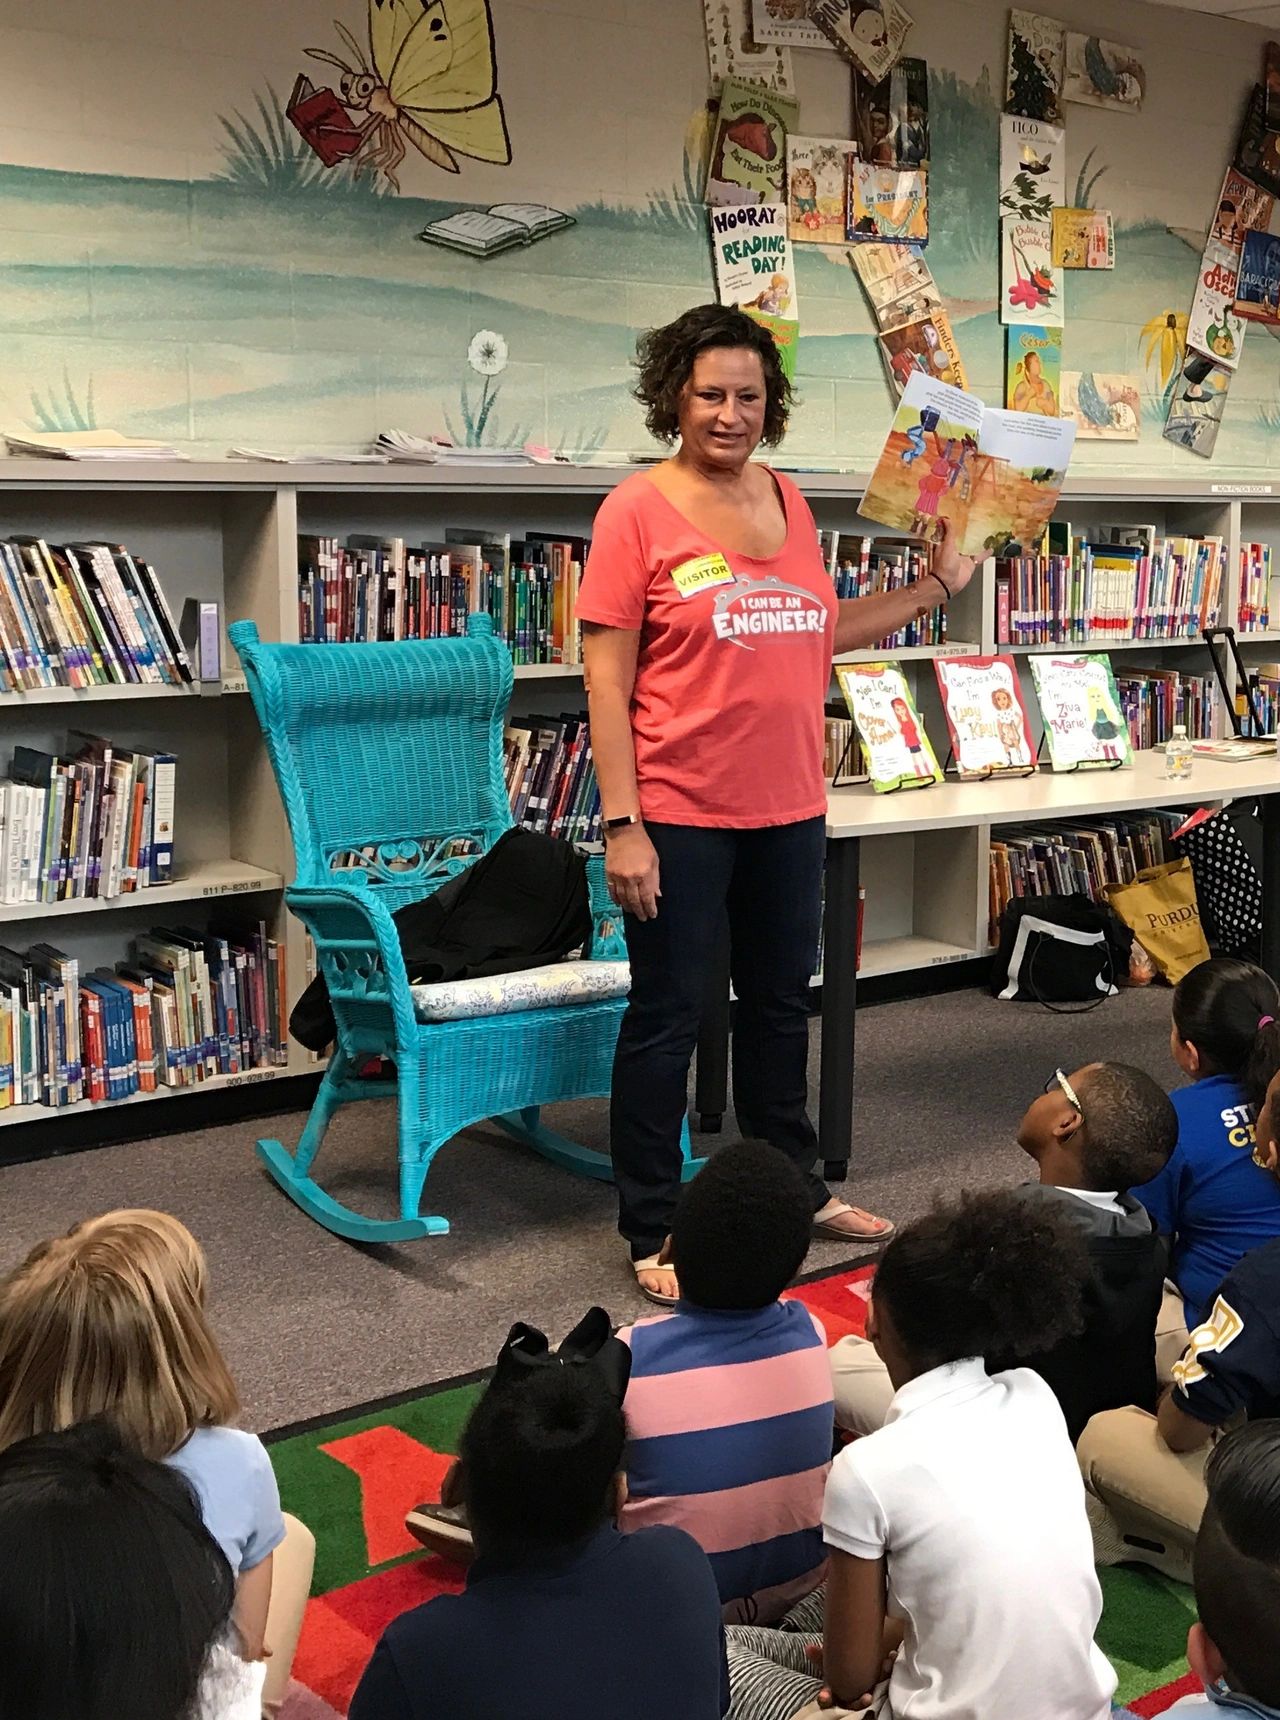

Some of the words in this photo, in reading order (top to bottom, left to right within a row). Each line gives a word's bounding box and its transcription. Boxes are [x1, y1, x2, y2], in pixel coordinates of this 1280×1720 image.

[1012, 121, 1039, 136] TICO
[714, 206, 777, 234] HOORAY
[721, 235, 786, 266] READING
[751, 256, 786, 275] DAY!
[1203, 270, 1236, 300] Osca
[934, 317, 955, 361] Finders
[679, 564, 729, 587] VISITOR
[739, 597, 746, 610] I
[747, 596, 768, 609] CAN
[768, 596, 782, 609] BE
[785, 596, 801, 609] AN
[711, 608, 828, 640] ENGINEER!
[1055, 703, 1081, 718] Ziva
[203, 887, 218, 896] 811
[1145, 903, 1200, 929] PURDU
